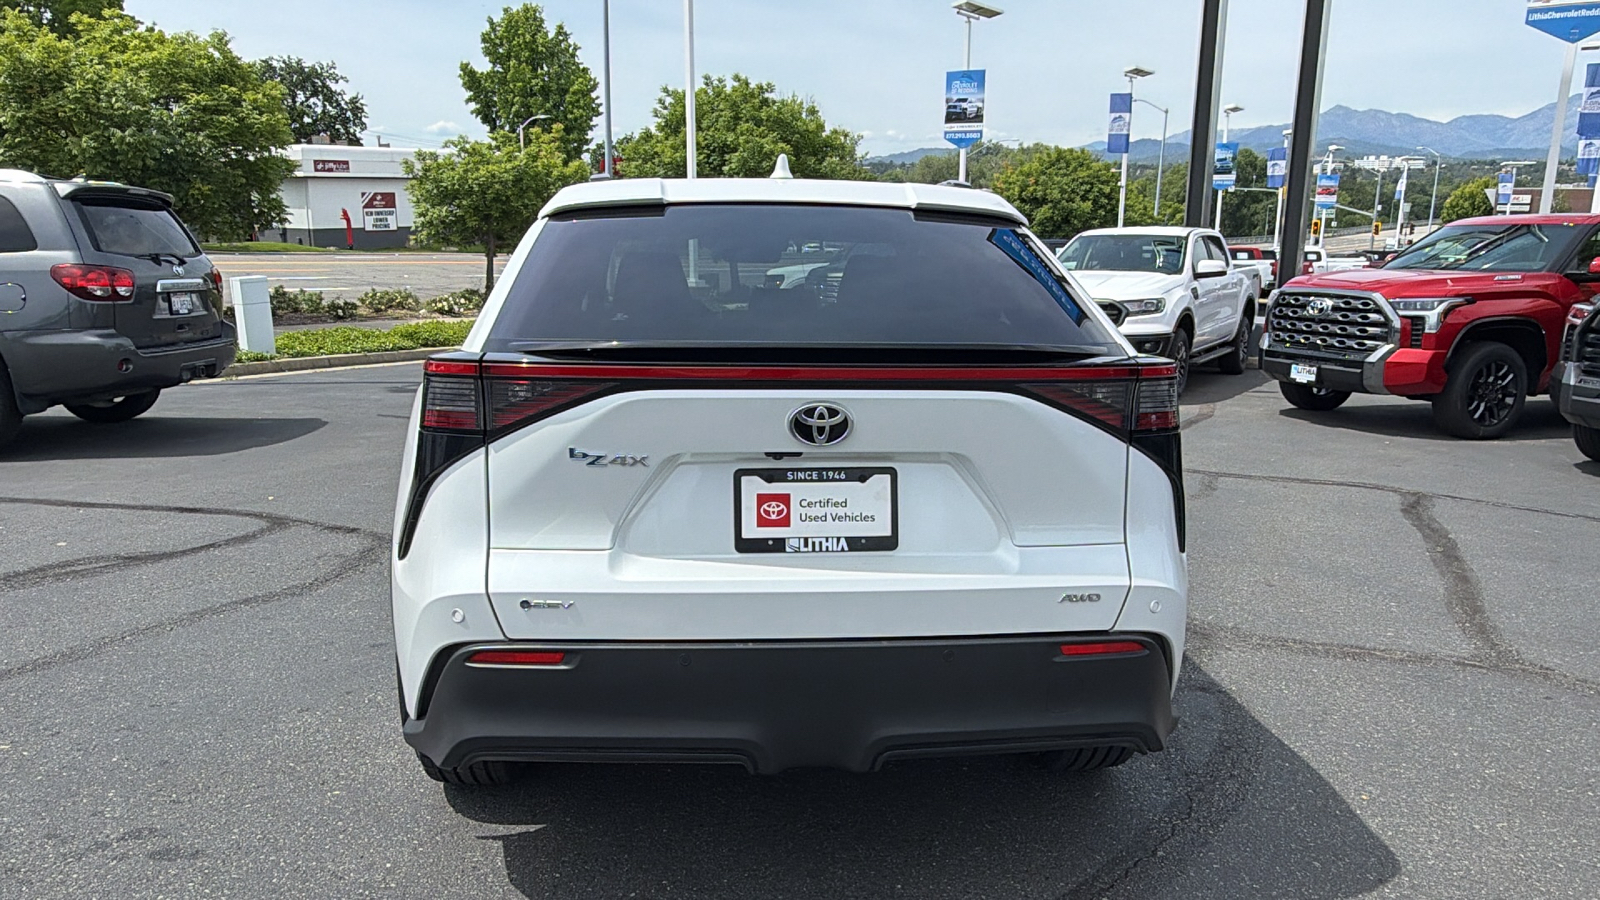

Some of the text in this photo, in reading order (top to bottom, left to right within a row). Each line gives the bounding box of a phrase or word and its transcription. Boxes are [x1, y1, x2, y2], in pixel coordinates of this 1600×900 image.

[787, 471, 846, 480] SINCE 1946
[799, 499, 848, 508] Certified
[799, 512, 876, 522] Used Vehicles
[802, 537, 849, 551] LITHIA
[1057, 593, 1101, 603] AWD
